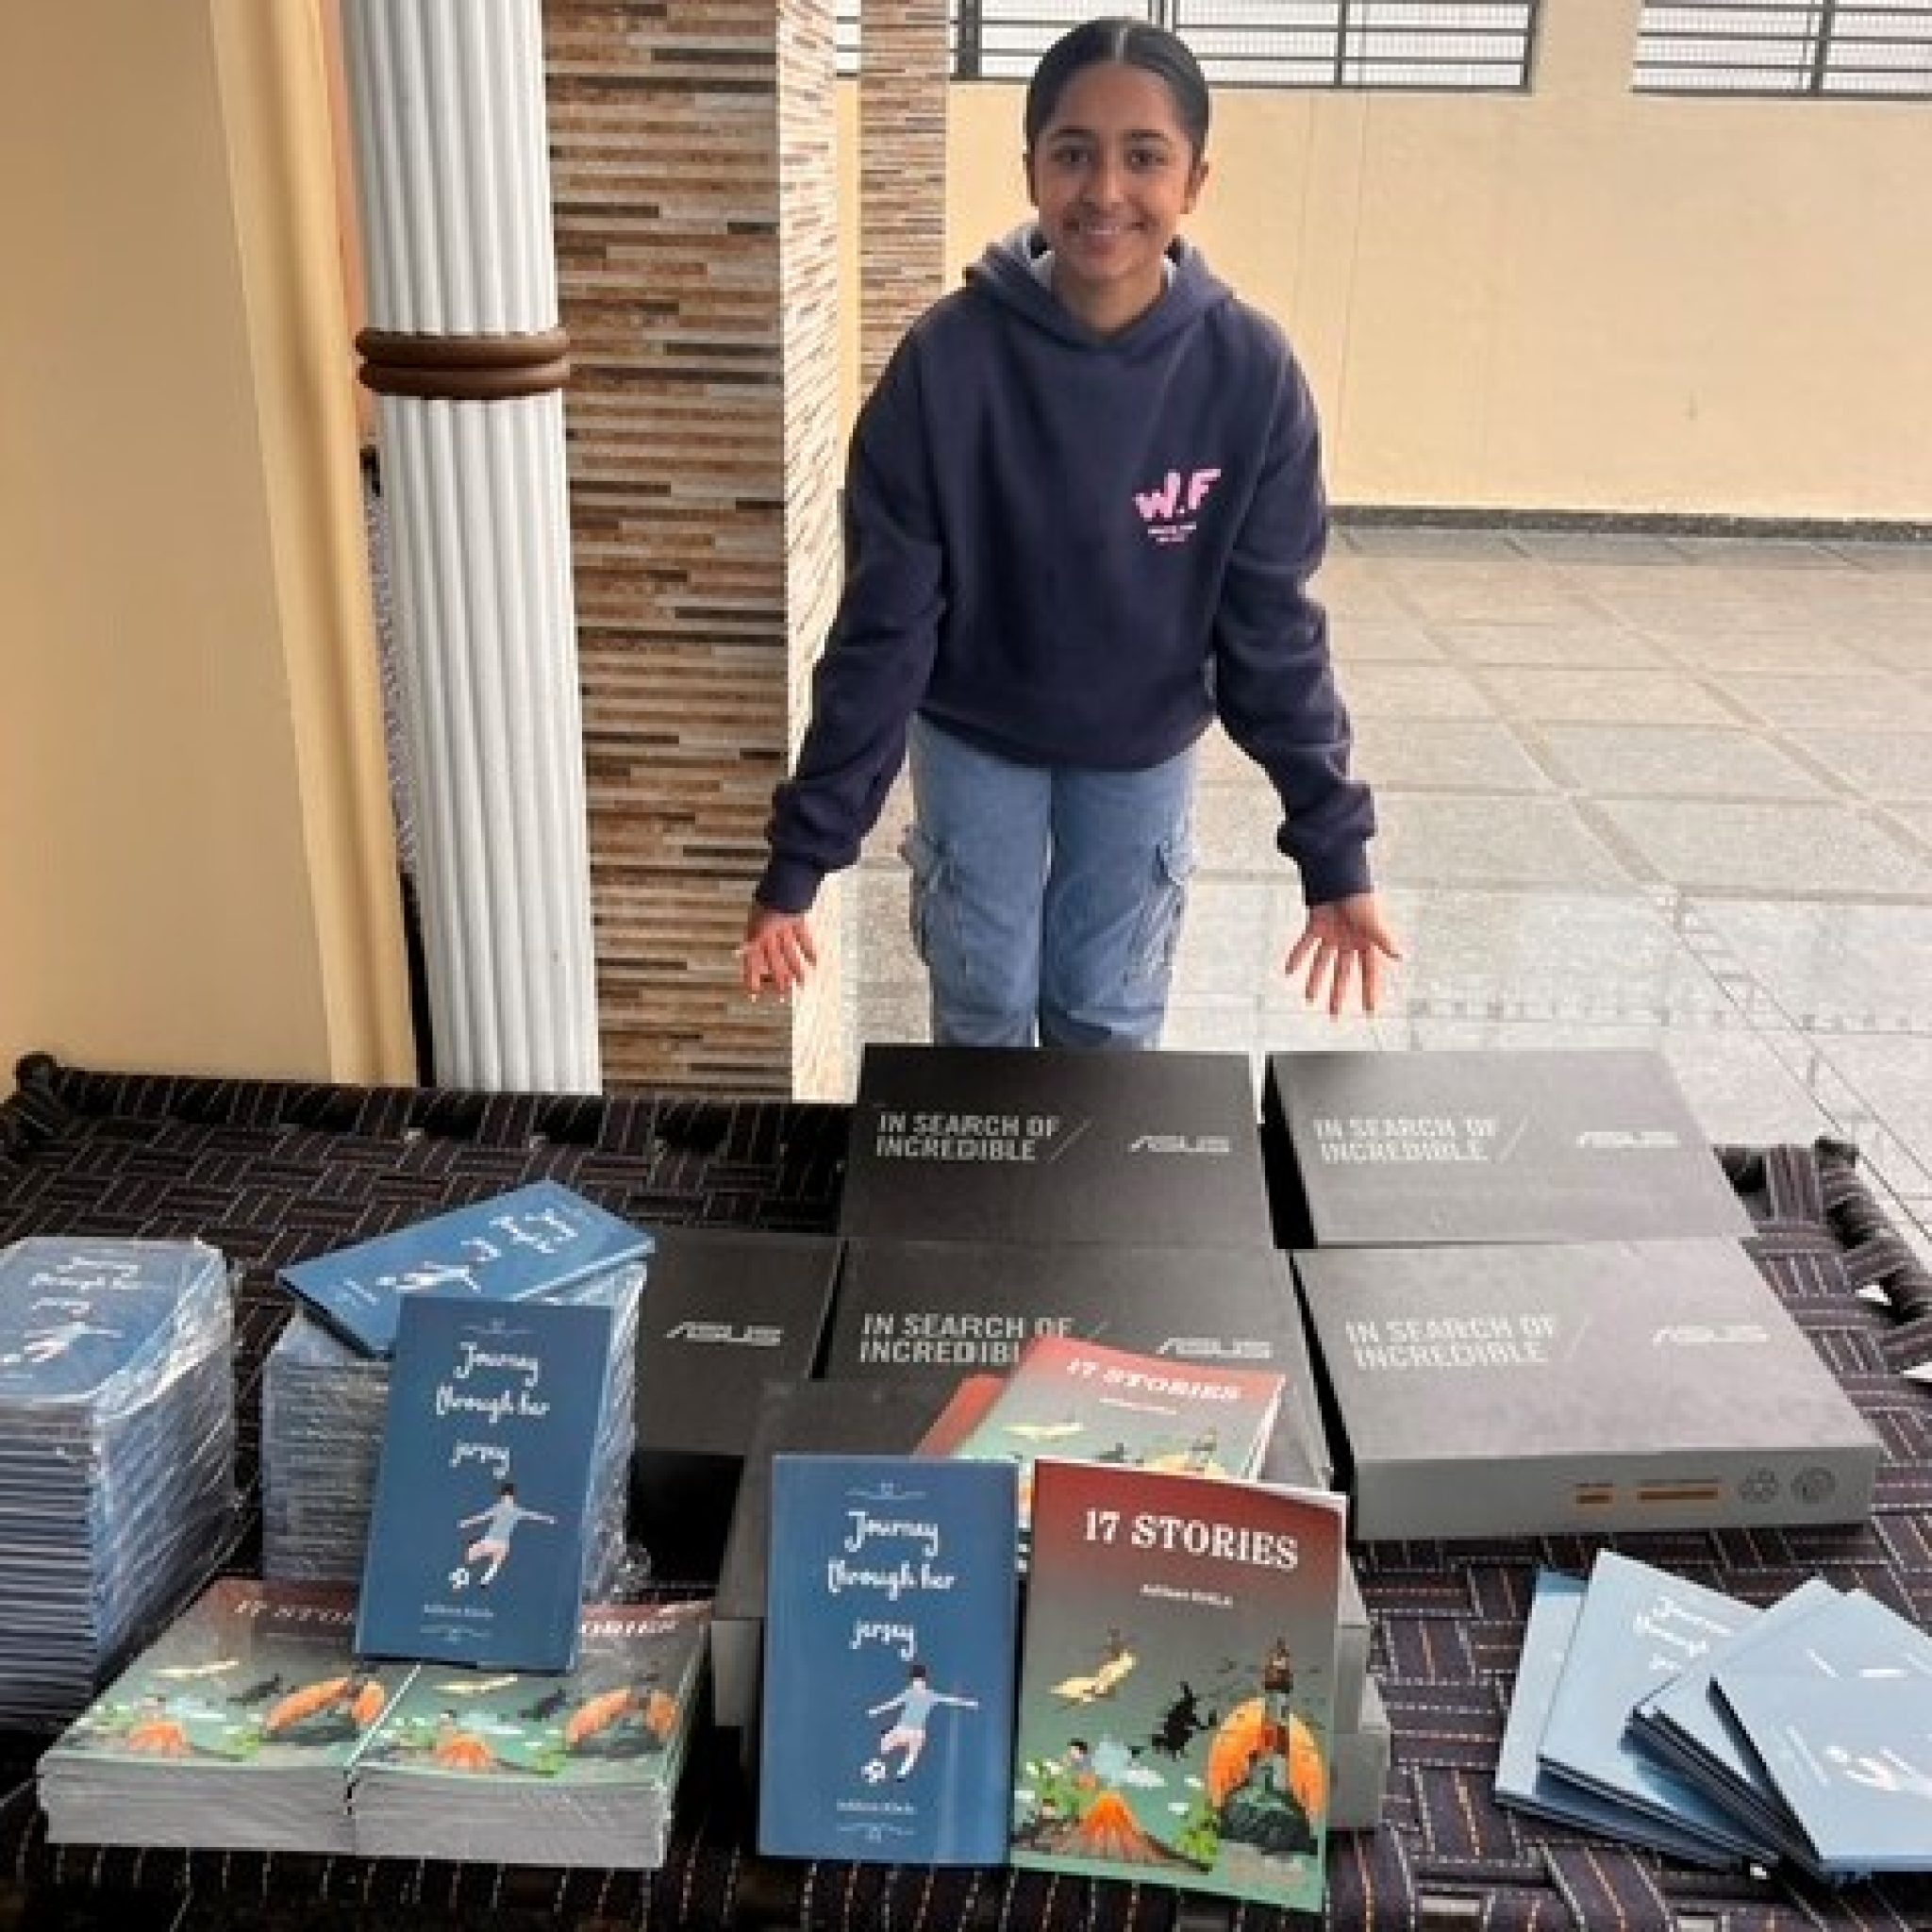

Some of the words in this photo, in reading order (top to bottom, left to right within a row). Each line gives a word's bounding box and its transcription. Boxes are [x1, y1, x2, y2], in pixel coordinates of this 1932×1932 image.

[879, 1113, 907, 1135] IN
[913, 1114, 1020, 1137] SEARCH
[1026, 1115, 1060, 1140] OF
[1313, 1118, 1342, 1140] IN
[1349, 1117, 1457, 1138] SEARCH
[876, 1134, 1037, 1161] INCREDIBLE
[1131, 1135, 1231, 1153] ASUS
[1321, 1139, 1489, 1164] INCREDIBLE
[666, 1321, 784, 1347] ASUS
[862, 1313, 894, 1336] IN
[903, 1312, 1025, 1340] SEARCH
[1034, 1316, 1075, 1339] OF
[1346, 1320, 1379, 1343] IN
[1386, 1317, 1513, 1340] SEARCH
[1158, 1336, 1273, 1359] ASUS
[1355, 1341, 1549, 1369] INCREDIBLE
[1103, 1367, 1242, 1401] STORIES
[844, 1510, 939, 1557] Journey
[1084, 1507, 1121, 1545] 17
[1131, 1512, 1300, 1574] STORIES
[827, 1557, 918, 1602] through
[850, 1617, 917, 1662] jersey
